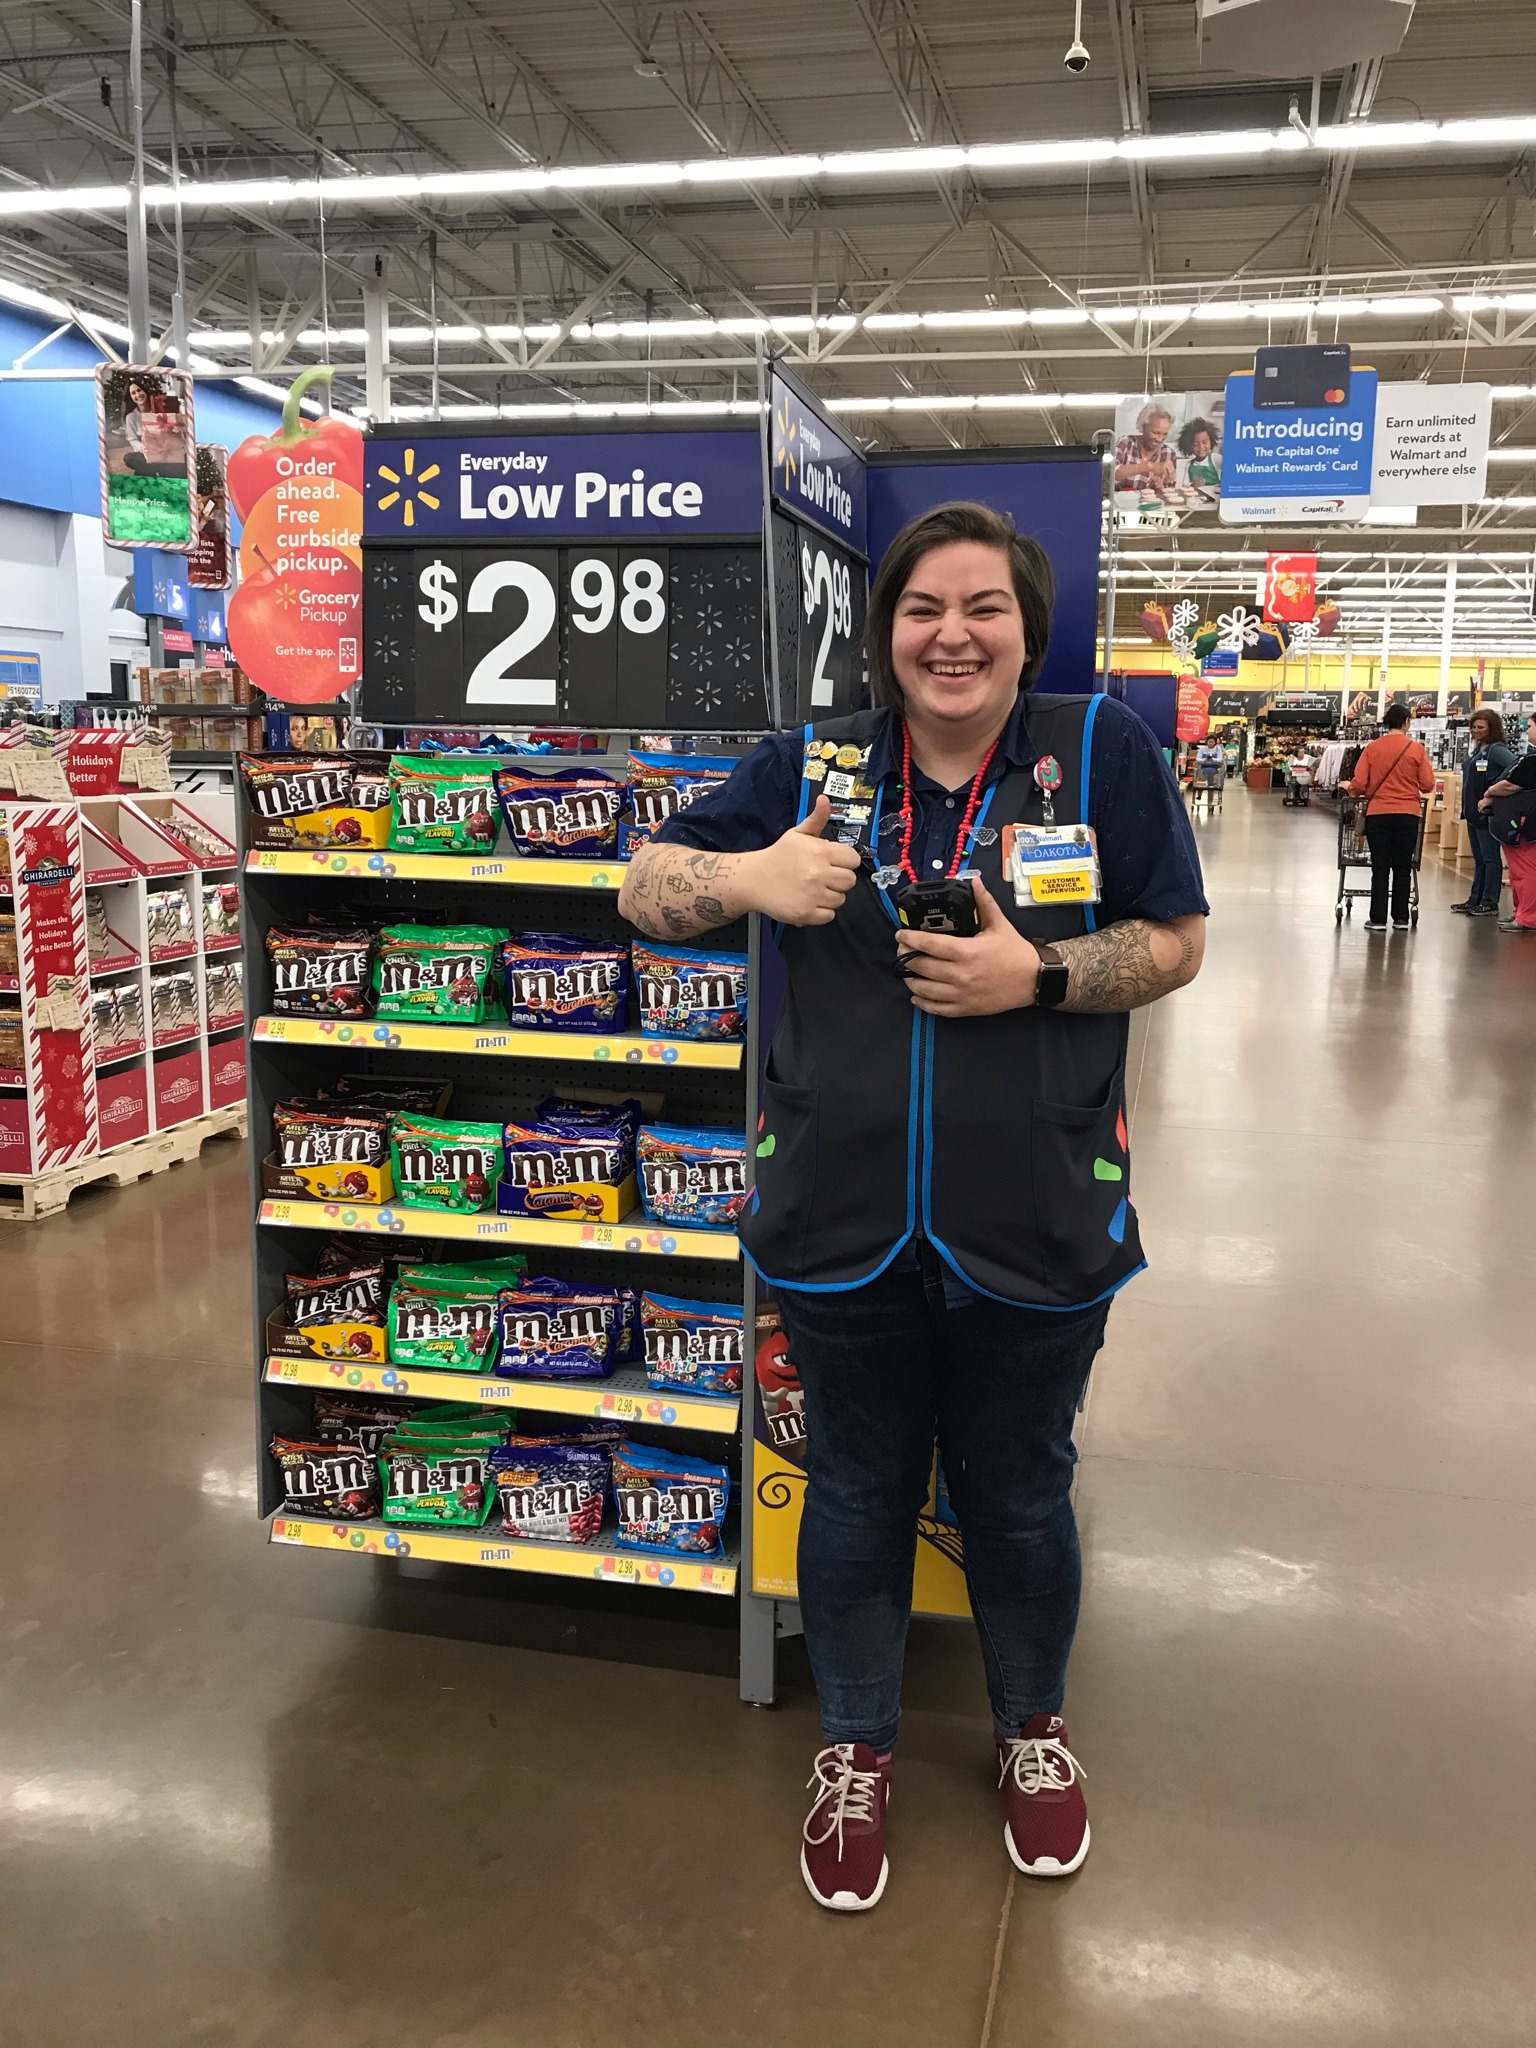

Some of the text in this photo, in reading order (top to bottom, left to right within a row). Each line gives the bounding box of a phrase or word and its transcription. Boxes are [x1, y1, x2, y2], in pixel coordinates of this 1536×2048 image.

[1386, 414, 1476, 428] Earn unlimited
[1235, 416, 1363, 442] Introducing
[799, 418, 821, 457] Everyday
[1397, 432, 1461, 444] rewards at
[1254, 447, 1273, 457] The
[1276, 446, 1313, 458] Capital
[1390, 447, 1467, 460] Walmart and
[276, 456, 336, 476] Order
[459, 453, 548, 475] Everyday
[1236, 463, 1279, 473] Walmart
[1332, 460, 1358, 471] Card
[1378, 464, 1476, 479] everywhere else
[276, 480, 341, 499] ahead.
[800, 443, 851, 528] Low Price
[459, 468, 703, 520] Low Price
[114, 496, 168, 507] Happy Price.
[277, 504, 320, 524] Free
[1242, 507, 1276, 515] Walmart
[277, 528, 361, 548] curbside
[277, 552, 348, 576] pickup.
[172, 585, 182, 610] 5
[299, 589, 360, 609] Grocery
[300, 607, 347, 626] Pickup
[275, 645, 336, 658] Get the app.
[72, 755, 113, 768] Holidays
[69, 772, 97, 782] Better
[252, 773, 273, 781] MILK
[576, 778, 606, 787] SHARING
[1037, 834, 1062, 842] Walmart
[1034, 846, 1079, 858] DAKOTA
[262, 854, 277, 866] 2.98
[24, 870, 74, 882] GHIRARDELLI
[36, 888, 64, 897] SQUARES
[1040, 886, 1085, 894] SUPERVISOR
[35, 916, 68, 928] Makes the
[38, 929, 67, 940] Holidays
[40, 943, 53, 952] Bite
[53, 940, 73, 950] Better
[706, 962, 735, 972] SHARING
[270, 1022, 285, 1034] 2.98
[217, 1067, 246, 1083] GHIRARDELL
[163, 1083, 197, 1101] GHIRARDELLI
[102, 1102, 141, 1120] GHIRARDELLI
[711, 1147, 742, 1157] SHARING
[398, 1146, 496, 1183] m&m's
[597, 1229, 613, 1241] 2.98
[574, 1295, 603, 1303] SHARING
[711, 1316, 740, 1326] SHARING
[283, 1364, 298, 1376] 2.98
[617, 1398, 632, 1412] 2.98
[567, 1453, 589, 1461] SHARING
[502, 1474, 533, 1483] CARAMEL
[683, 1472, 711, 1483] SHARING
[547, 1518, 557, 1526] BLUE
[287, 1524, 301, 1537] 2.98
[618, 1560, 633, 1573] 2.98
